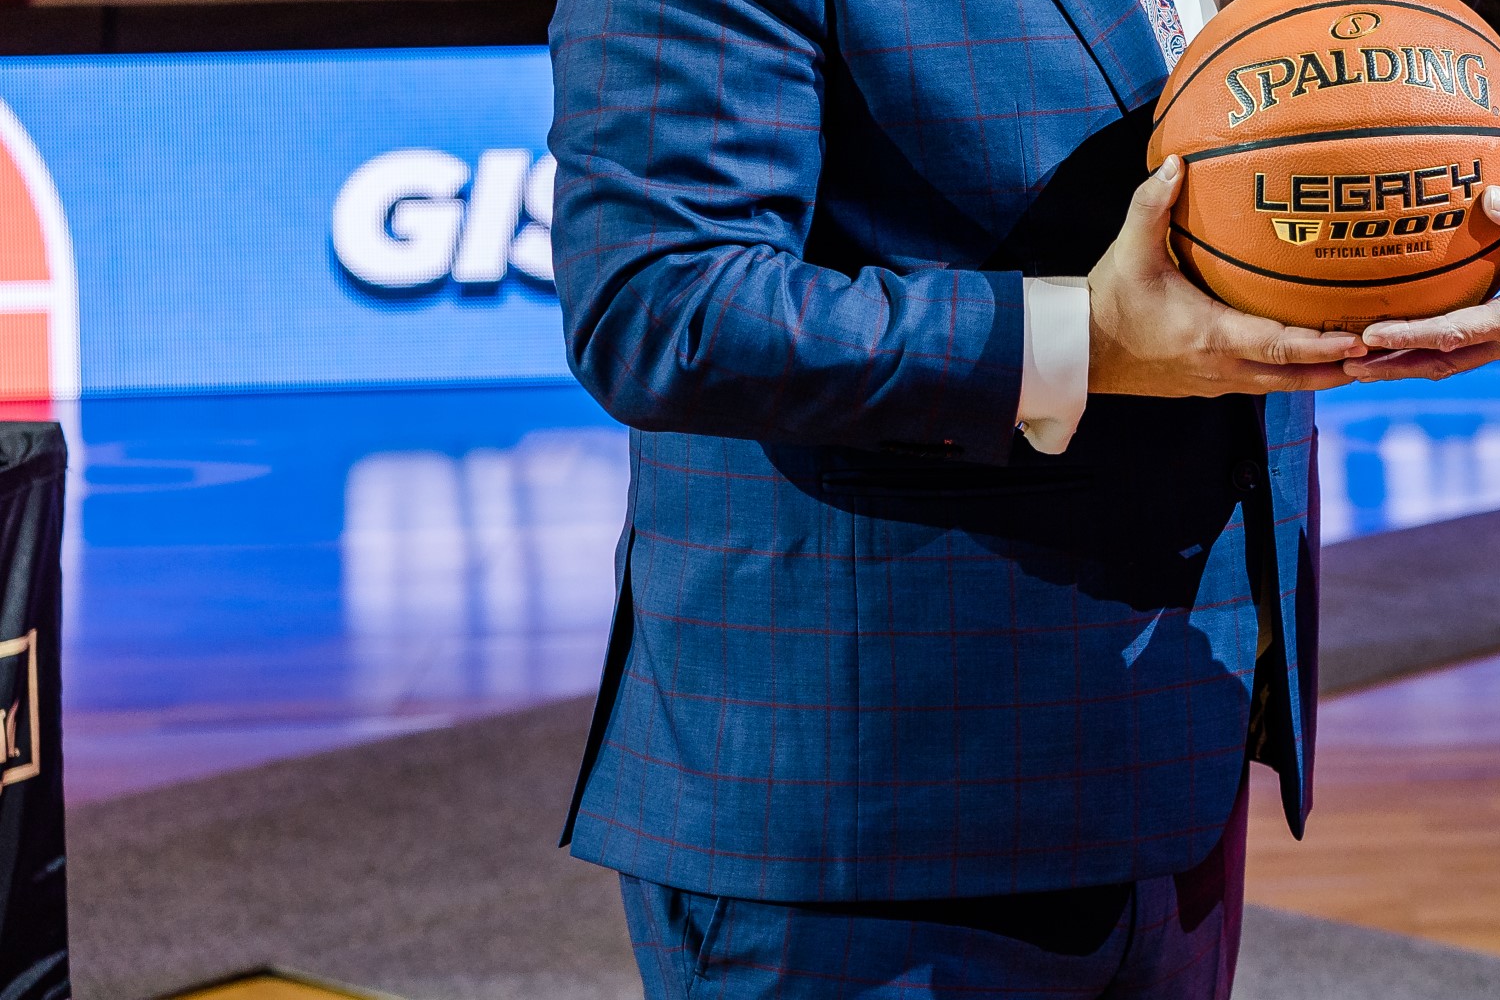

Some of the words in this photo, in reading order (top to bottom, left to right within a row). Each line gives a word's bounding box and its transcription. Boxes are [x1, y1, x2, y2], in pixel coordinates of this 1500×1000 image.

[1224, 45, 1494, 128] SPALDING
[1254, 159, 1484, 213] LEGACY
[1329, 208, 1467, 241] 1000
[1314, 246, 1367, 259] OFFICIAL
[1371, 244, 1403, 258] GAME
[1405, 240, 1433, 254] BALL
